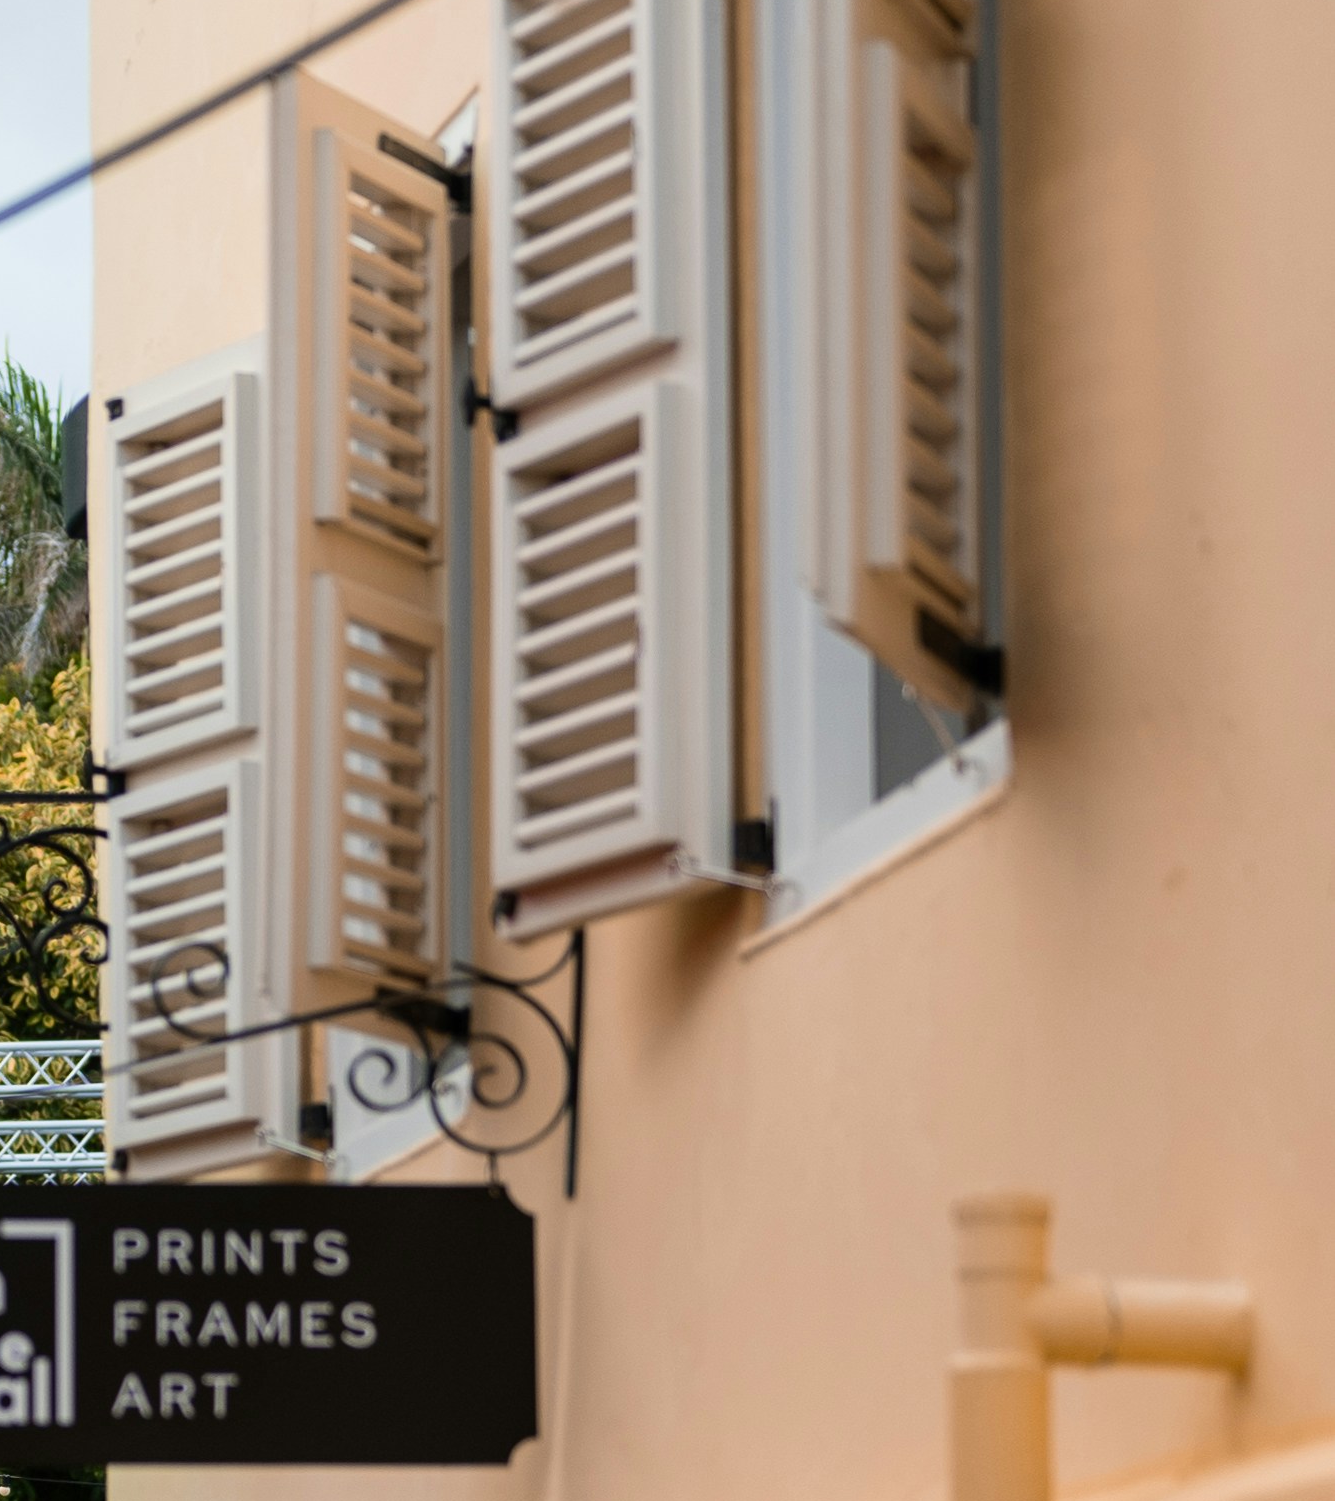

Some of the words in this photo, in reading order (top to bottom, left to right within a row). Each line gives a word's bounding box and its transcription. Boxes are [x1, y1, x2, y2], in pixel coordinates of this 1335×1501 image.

[112, 1228, 350, 1276] PRINTS
[112, 1300, 378, 1348] FRAMES
[111, 1372, 238, 1419] ART
